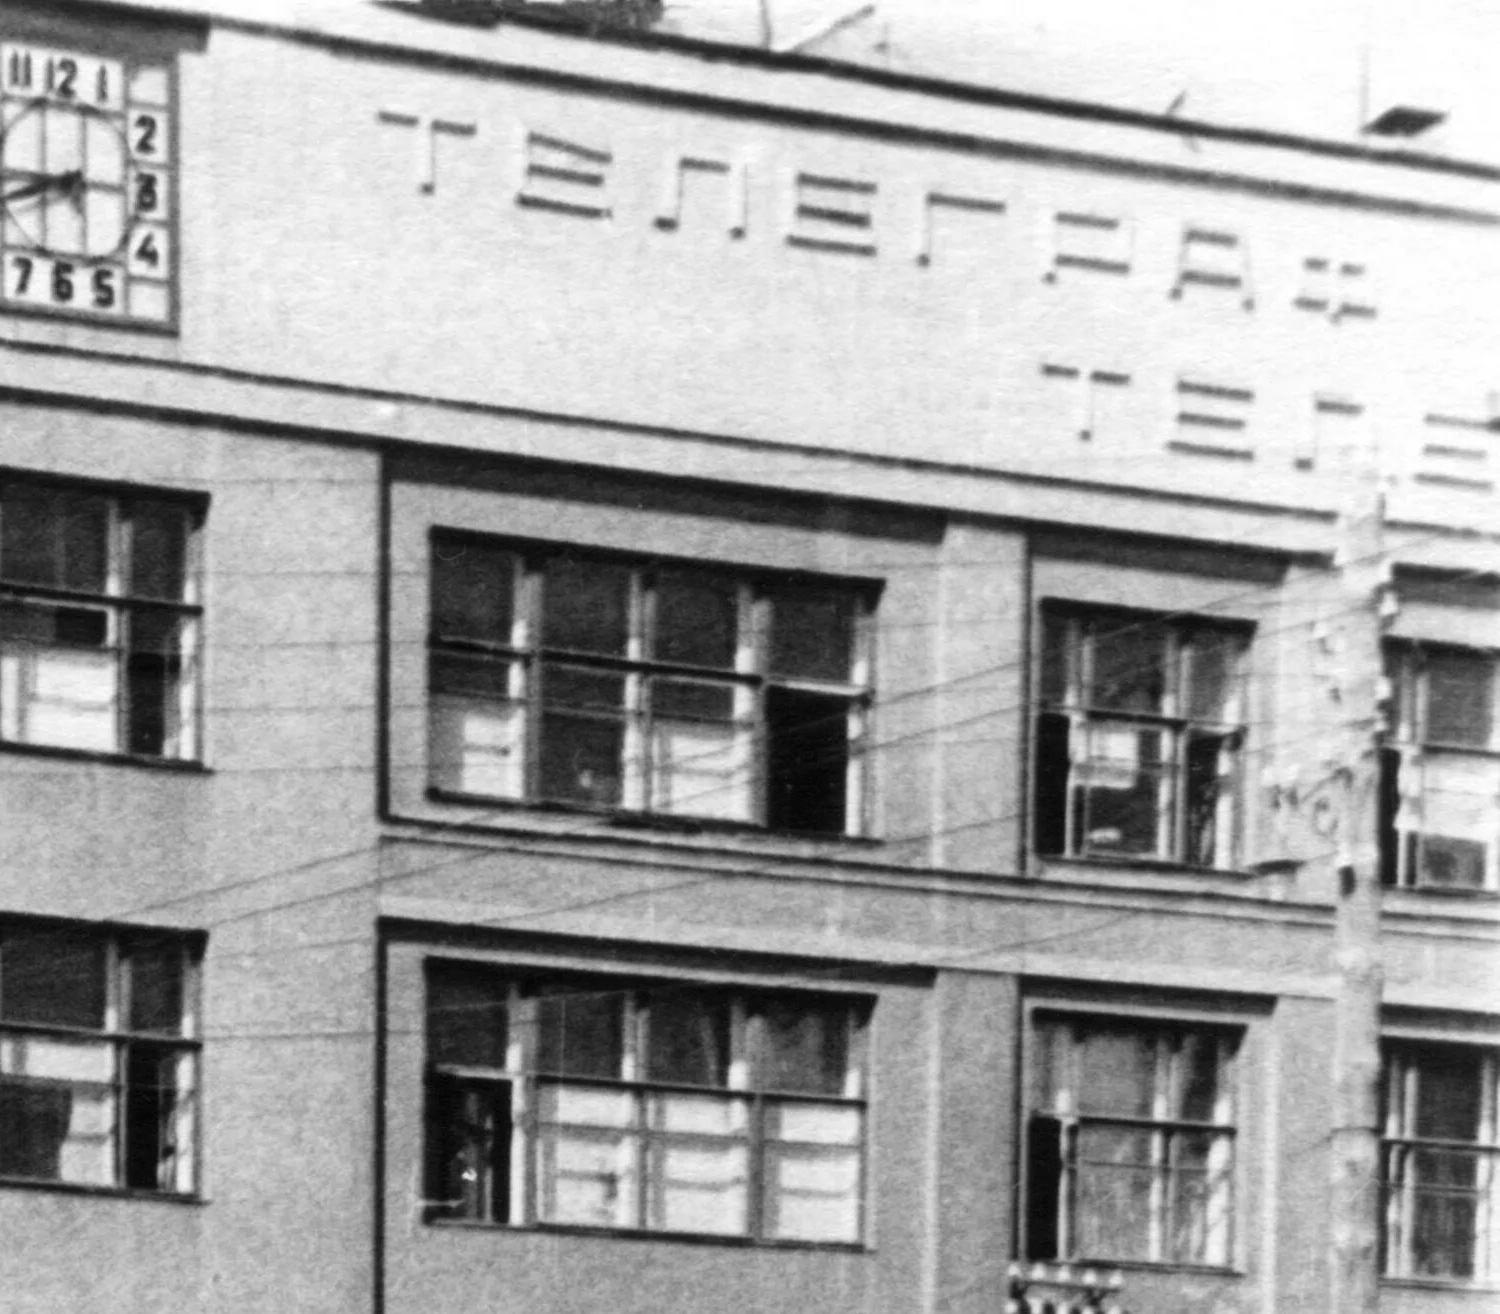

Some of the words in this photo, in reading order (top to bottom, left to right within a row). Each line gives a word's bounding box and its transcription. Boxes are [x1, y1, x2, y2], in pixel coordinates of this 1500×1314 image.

[9, 48, 32, 90] 11
[46, 56, 78, 99] 12
[96, 66, 109, 103] 1
[134, 114, 158, 156] 2
[134, 171, 159, 214] 3
[375, 109, 1378, 324] ТЕЛЕГРАФ
[135, 232, 160, 269] 4
[13, 256, 34, 296] 7
[52, 260, 75, 303] 6
[91, 268, 116, 310] 5
